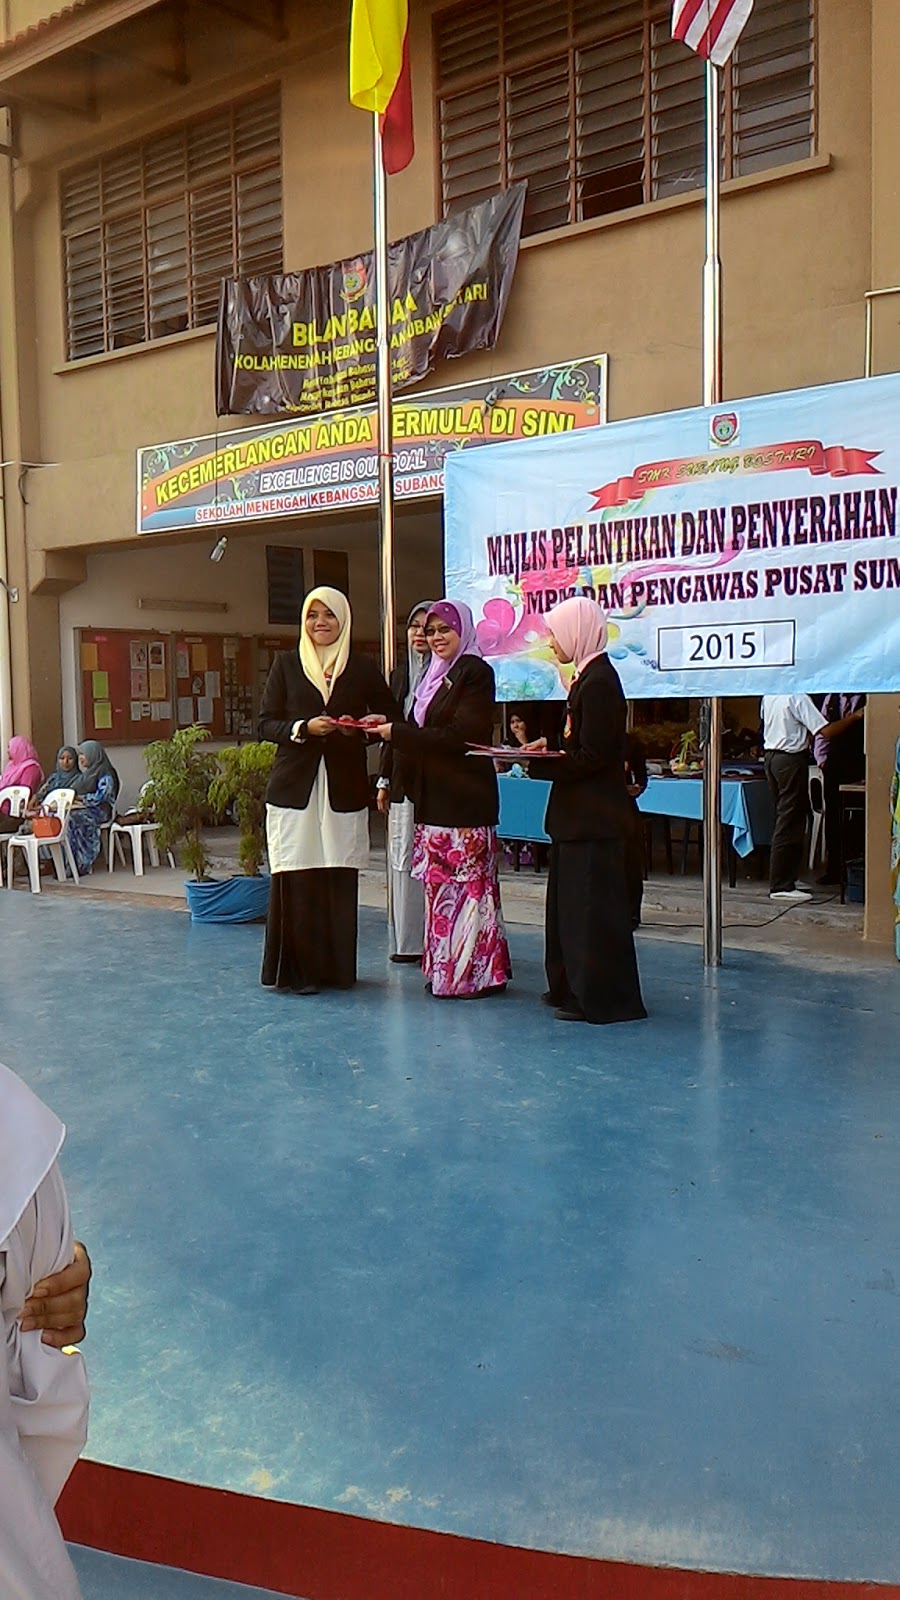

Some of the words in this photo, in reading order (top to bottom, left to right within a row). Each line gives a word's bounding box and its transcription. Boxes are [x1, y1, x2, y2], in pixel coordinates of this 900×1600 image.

[156, 429, 311, 505] KECEMERLANGAN
[316, 415, 372, 449] ANDA
[392, 408, 484, 437] ERMULA
[490, 408, 516, 435] DI
[522, 408, 575, 436] SINI
[260, 461, 339, 493] EXCELLENCE
[341, 459, 354, 480] IS
[355, 455, 380, 478] OU
[638, 468, 672, 484] SMK
[676, 456, 740, 479] SUBANG
[196, 502, 243, 522] SEKOLAH
[246, 493, 307, 515] MENENGAH
[310, 483, 380, 506] KEBANGSAA
[487, 530, 547, 584] MAJLIS
[551, 513, 676, 569] PELANTIKAN
[681, 507, 726, 557] DAN
[731, 486, 898, 551] PENYERAHAN
[630, 569, 759, 607] PENGAWAS
[765, 562, 847, 597] PUSAT
[689, 631, 756, 662] 2015
